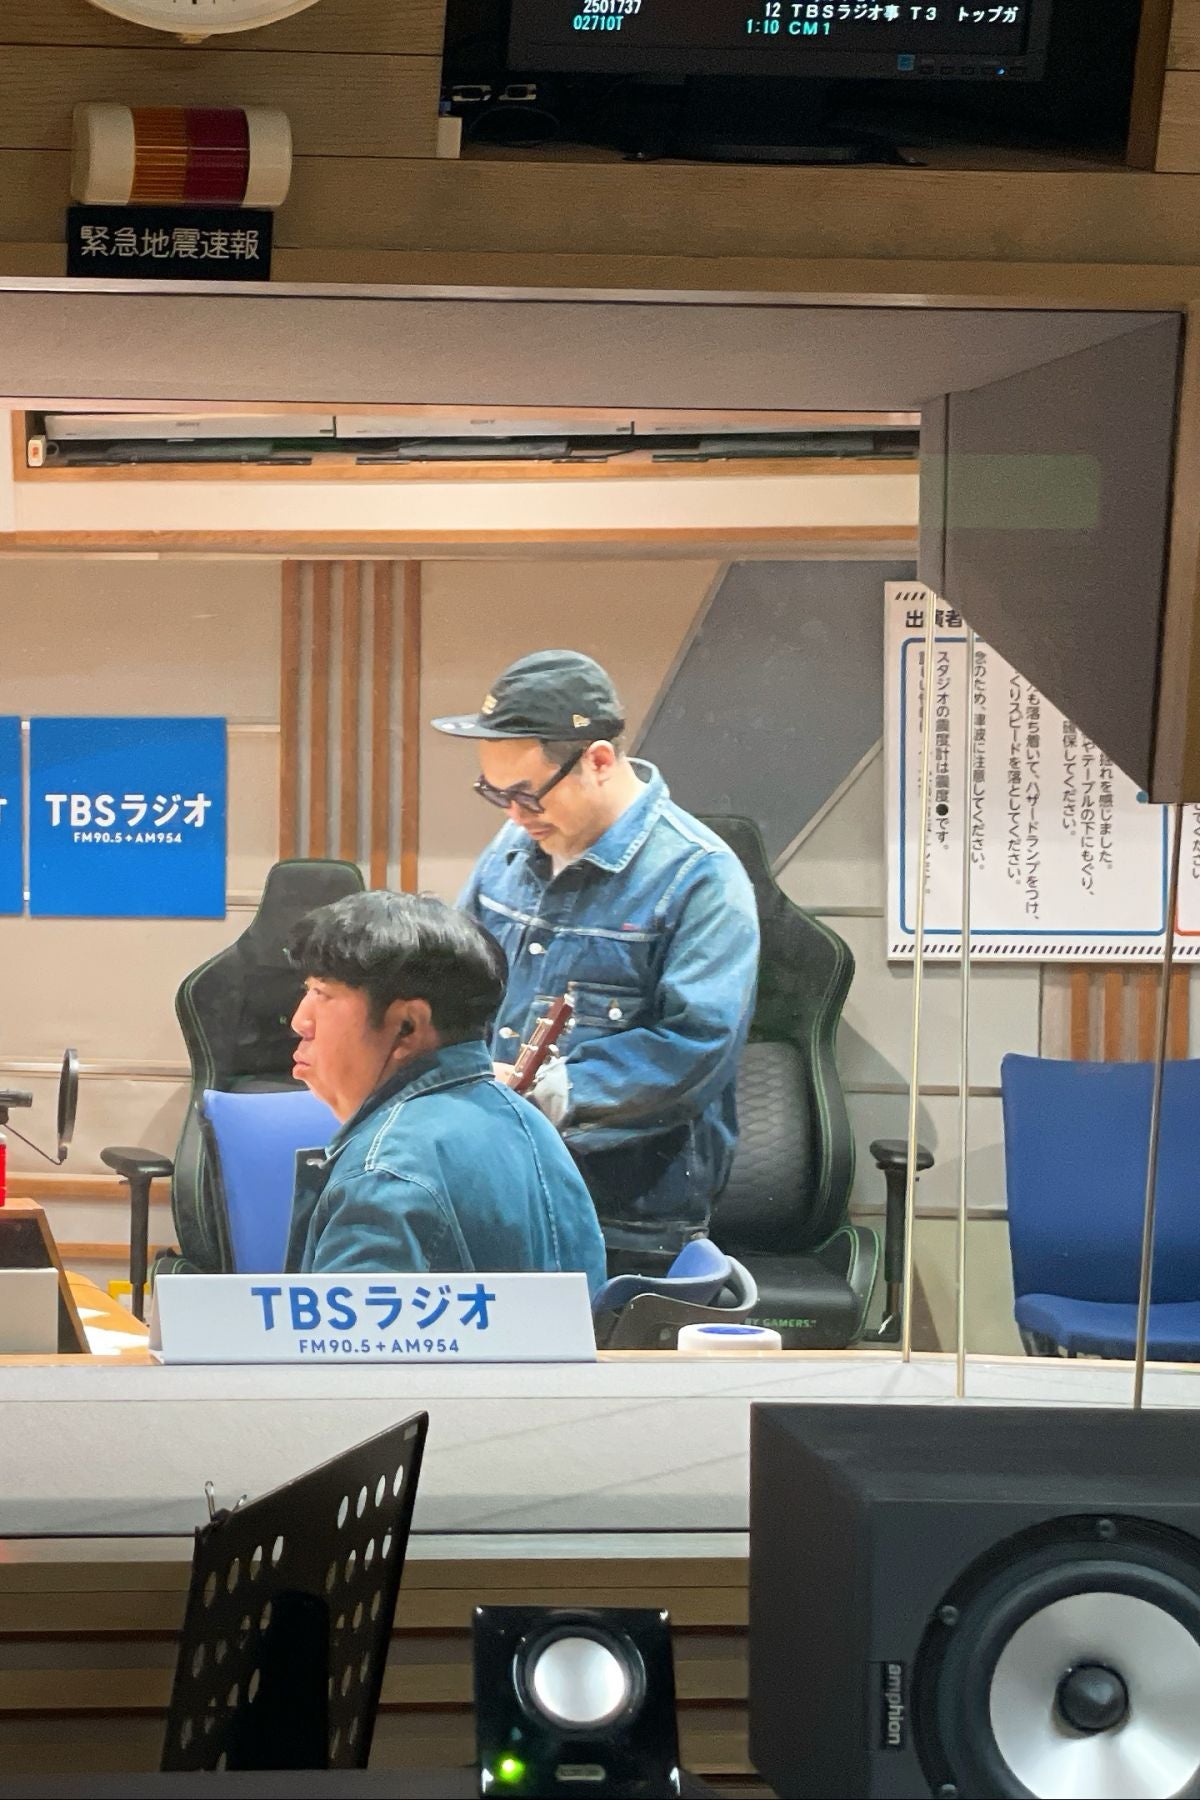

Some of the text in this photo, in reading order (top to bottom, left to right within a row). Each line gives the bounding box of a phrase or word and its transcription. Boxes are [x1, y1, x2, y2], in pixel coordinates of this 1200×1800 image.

[583, 0, 641, 14] 2501737
[765, 3, 781, 17] 12
[573, 15, 623, 31] 02710T
[747, 20, 830, 35] 1:10 CM1
[80, 225, 260, 260] 緊急地震速報
[45, 793, 212, 827] TBSラジオ
[251, 1284, 496, 1330] TBSラジオ
[885, 1664, 904, 1745] amphion
